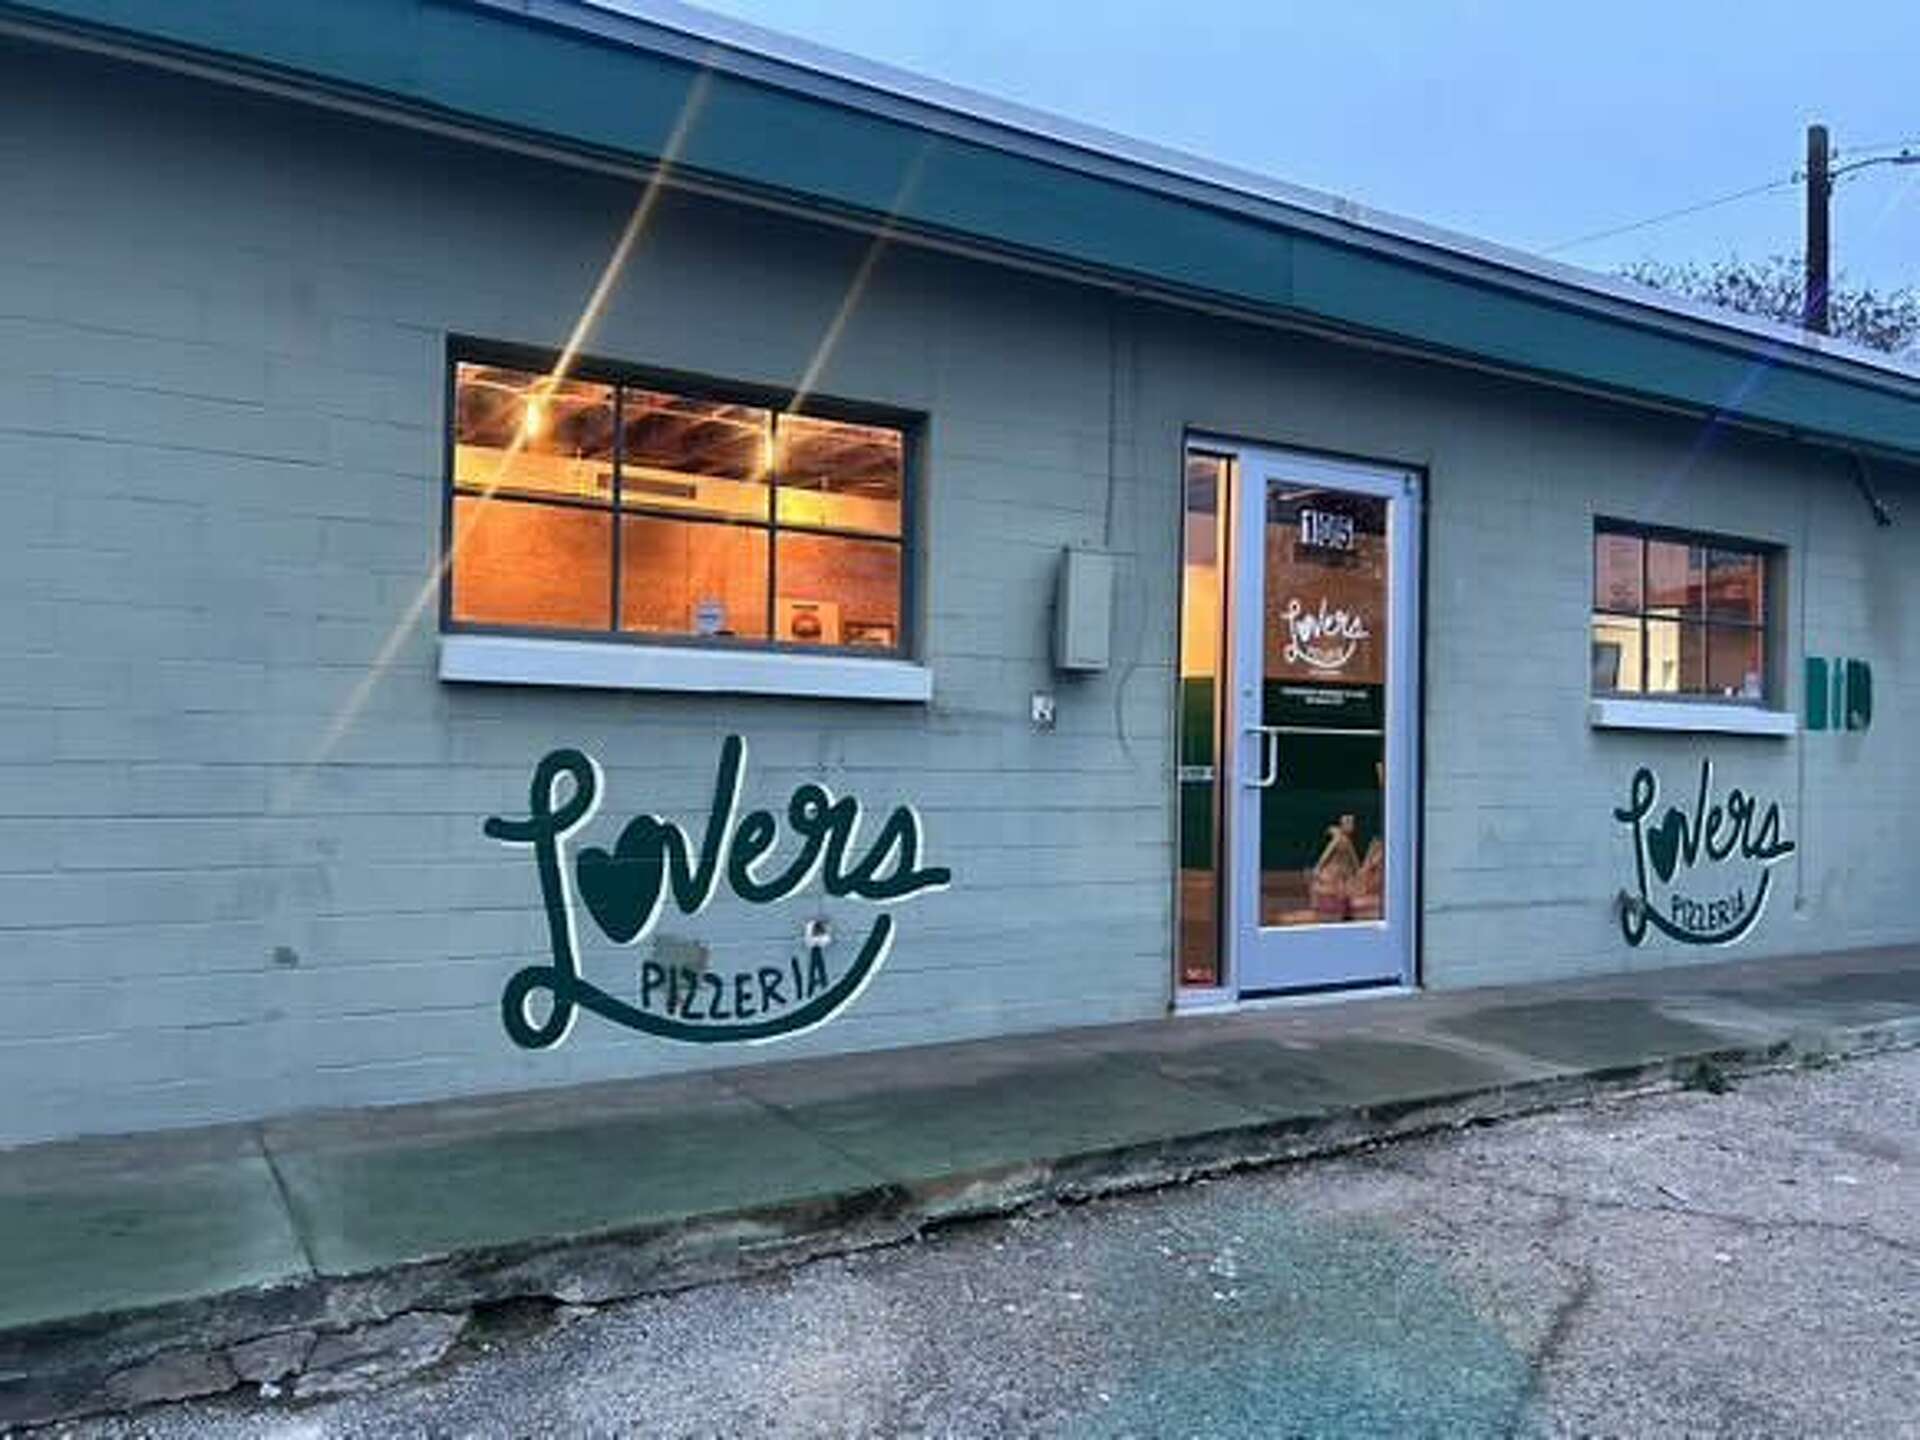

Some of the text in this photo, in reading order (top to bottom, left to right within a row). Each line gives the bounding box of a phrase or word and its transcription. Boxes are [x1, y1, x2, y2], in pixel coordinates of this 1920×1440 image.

[1280, 597, 1371, 668] Lovers
[484, 735, 953, 1049] Lovers
[1614, 757, 1796, 947] Lovers
[641, 946, 832, 1020] PIZZERIA
